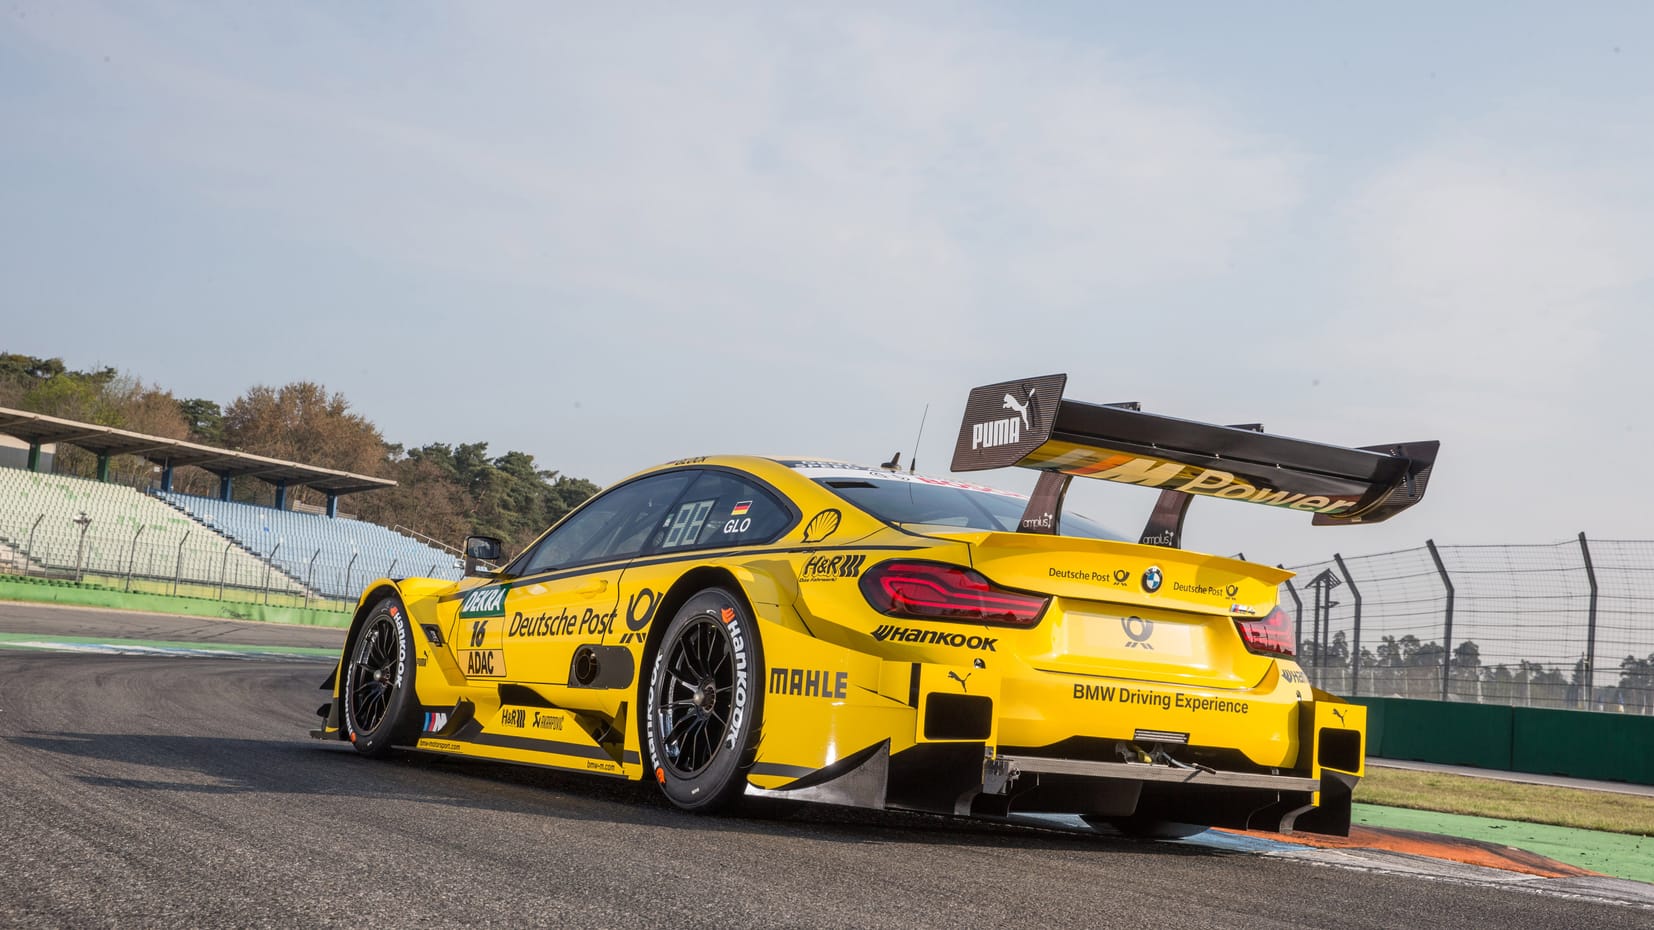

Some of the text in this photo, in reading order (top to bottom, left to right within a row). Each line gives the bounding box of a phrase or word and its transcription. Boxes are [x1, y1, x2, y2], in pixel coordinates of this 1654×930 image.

[972, 417, 1020, 450] PUMA
[1097, 458, 1357, 514] M Power
[723, 517, 752, 534] GLO
[803, 555, 843, 575] H&R
[1048, 567, 1110, 582] Deutsche Post
[462, 588, 506, 612] DEKRA
[1173, 581, 1223, 597] Deutsche Post
[470, 620, 488, 648] 16
[508, 607, 617, 637] Deutsche Post
[467, 650, 494, 675] ADAC
[769, 667, 848, 699] MAHLE
[1073, 683, 1249, 714] BMW Driving Experience
[502, 709, 517, 726] H&R
